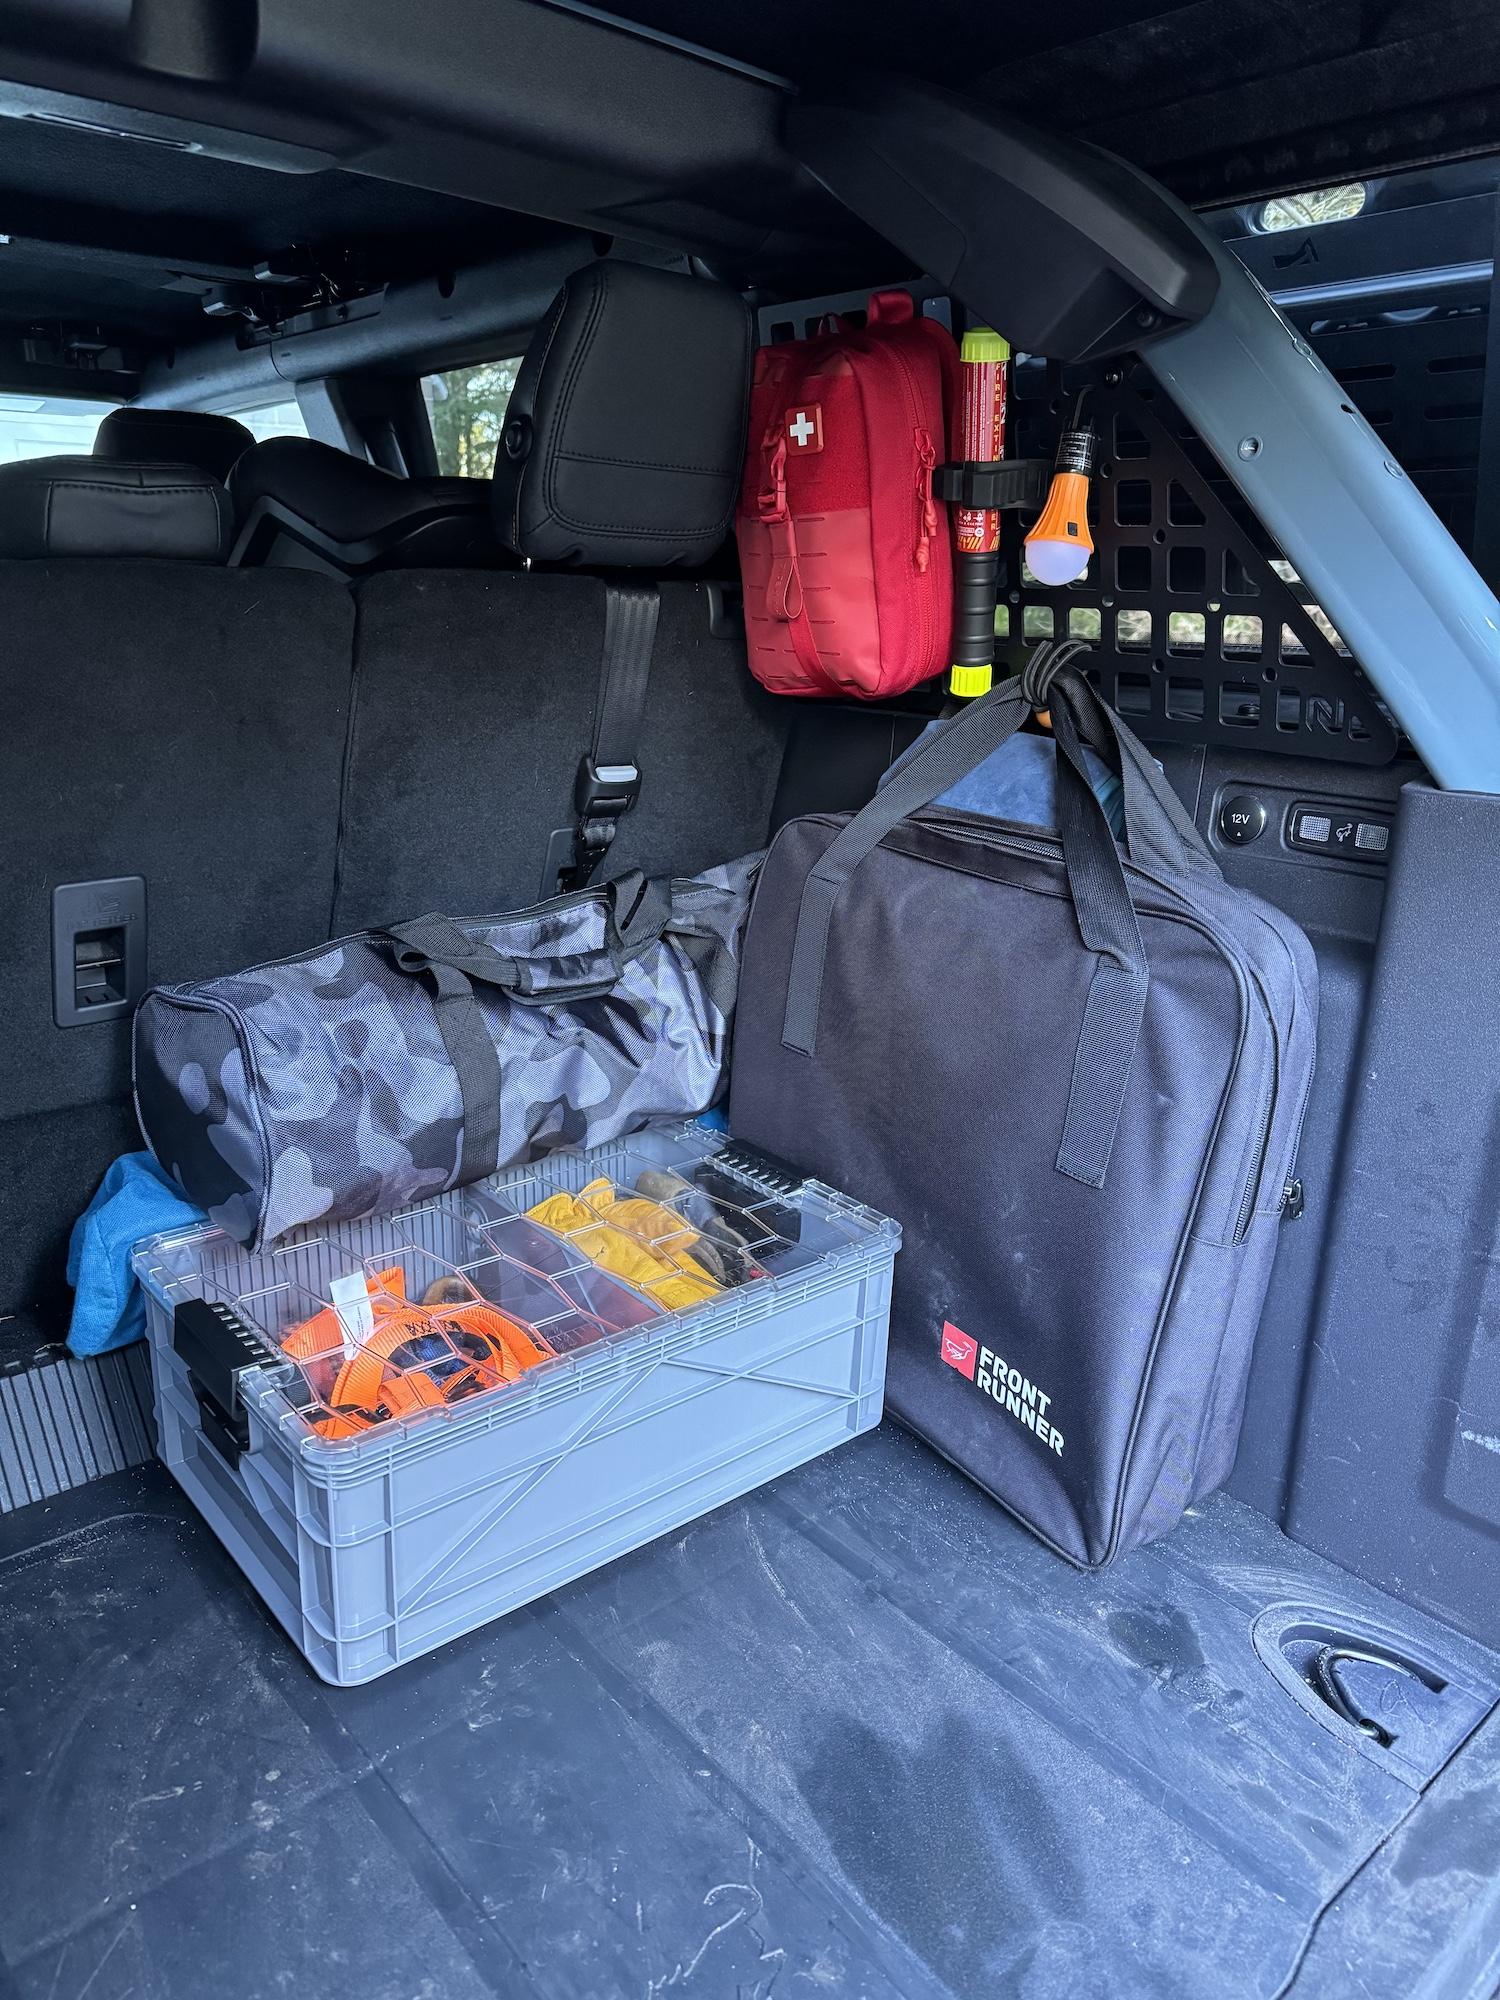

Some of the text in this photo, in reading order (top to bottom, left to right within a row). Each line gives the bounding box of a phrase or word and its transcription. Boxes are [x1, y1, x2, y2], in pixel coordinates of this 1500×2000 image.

[1231, 813, 1250, 825] 12V
[976, 1366, 1065, 1457] RUNNER
[979, 1345, 1052, 1416] FRONT
